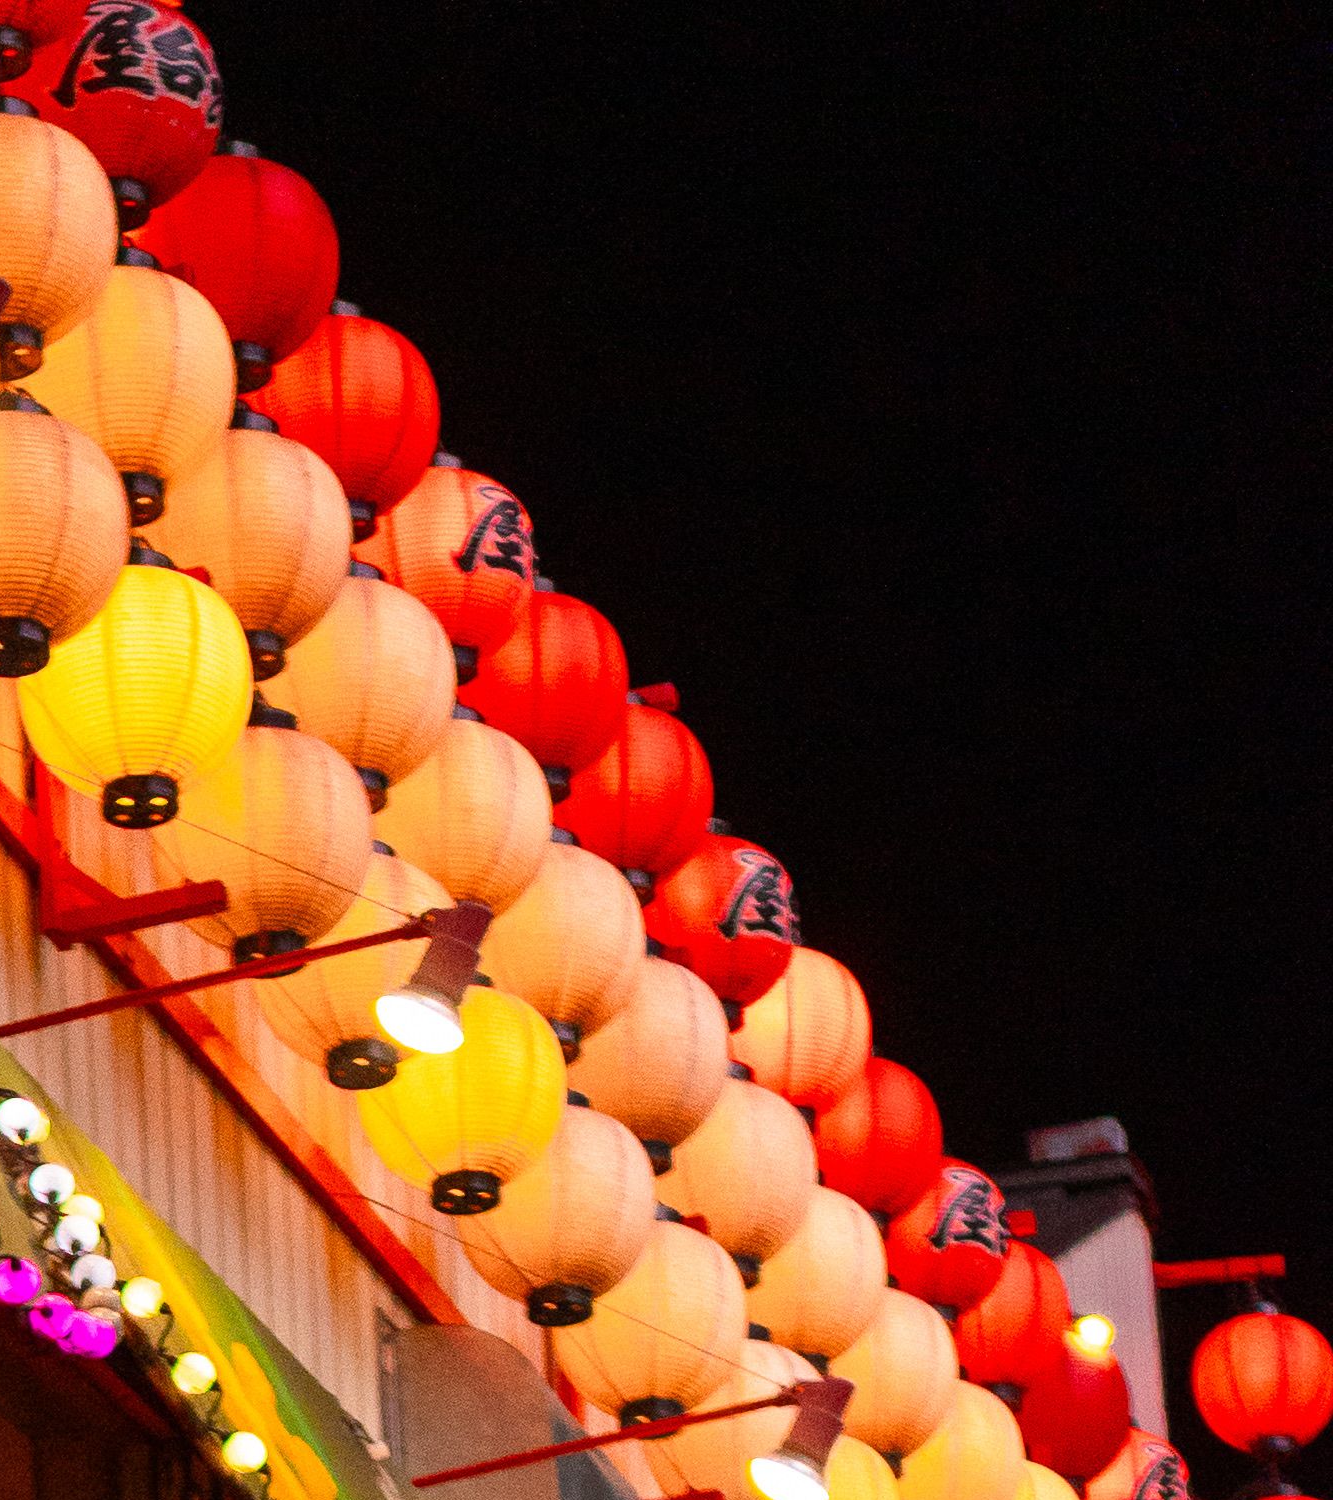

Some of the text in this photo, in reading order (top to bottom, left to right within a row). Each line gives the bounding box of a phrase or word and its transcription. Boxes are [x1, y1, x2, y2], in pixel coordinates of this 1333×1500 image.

[52, 0, 224, 129] 屋台
[715, 847, 802, 945] 屋
[929, 1166, 1011, 1258] 屋
